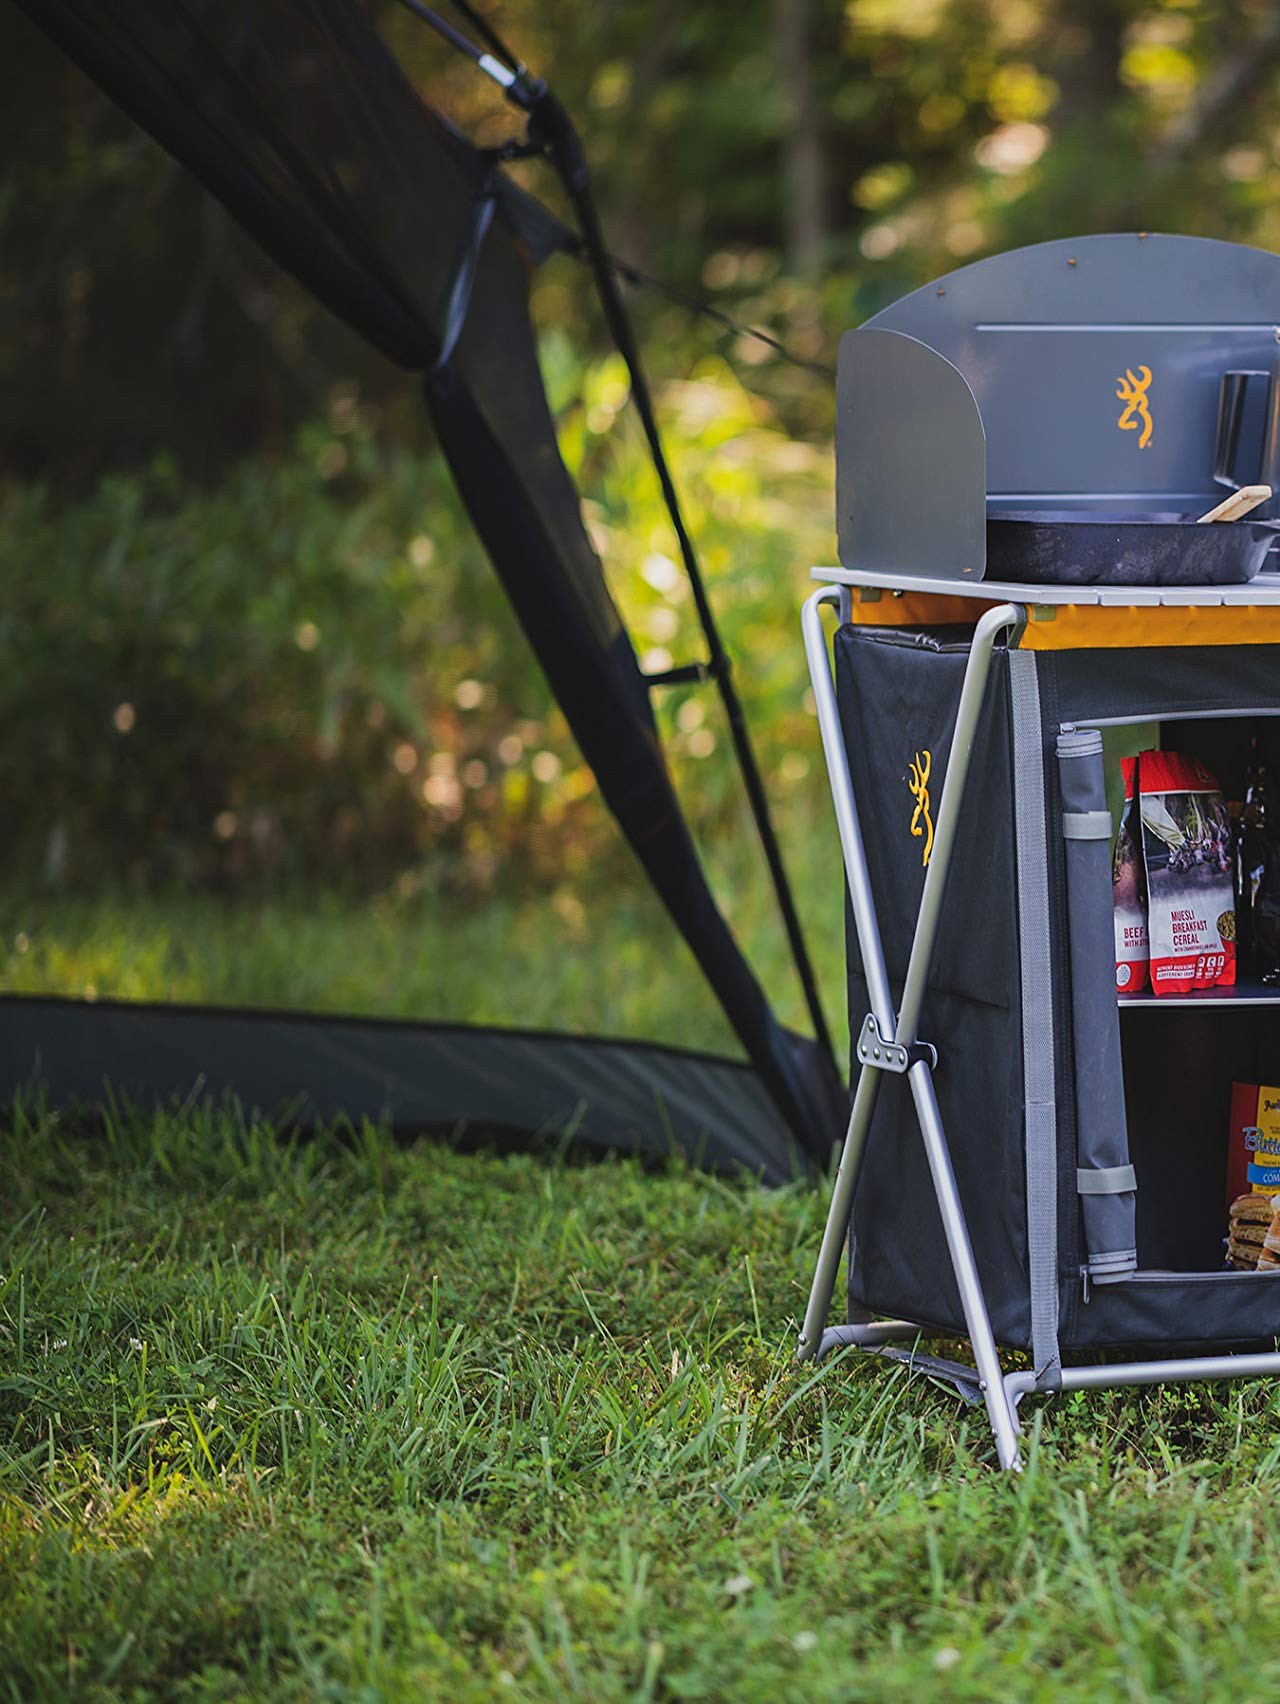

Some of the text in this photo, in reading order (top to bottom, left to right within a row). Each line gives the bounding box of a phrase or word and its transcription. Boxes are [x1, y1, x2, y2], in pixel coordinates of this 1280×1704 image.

[1171, 910, 1195, 922] MUESLI
[1124, 927, 1143, 939] BEEF
[1172, 920, 1208, 934] BREAKFAST
[1173, 934, 1200, 946] CEREAL
